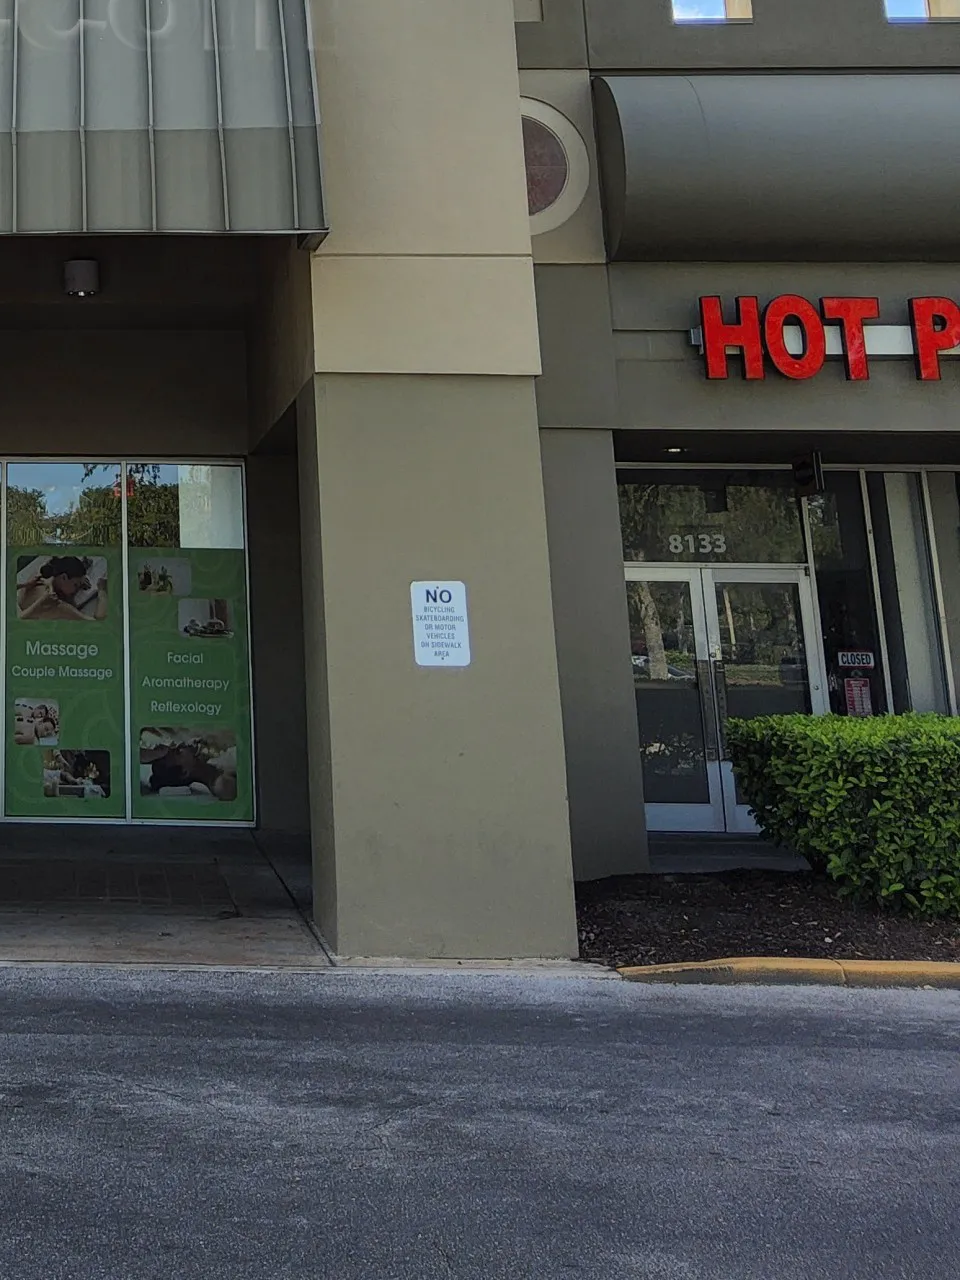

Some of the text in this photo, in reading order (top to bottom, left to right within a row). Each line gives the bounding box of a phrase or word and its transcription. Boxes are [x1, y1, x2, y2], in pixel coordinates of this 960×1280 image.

[699, 293, 960, 381] HOT P
[668, 534, 727, 554] 8133
[426, 589, 452, 603] NO
[26, 640, 99, 660] Massage
[167, 651, 204, 664] Facial
[840, 653, 872, 665] CLOSED
[11, 665, 113, 680] Couple Massage
[142, 676, 230, 691] Aromatherapy
[150, 700, 222, 716] Reflexology
